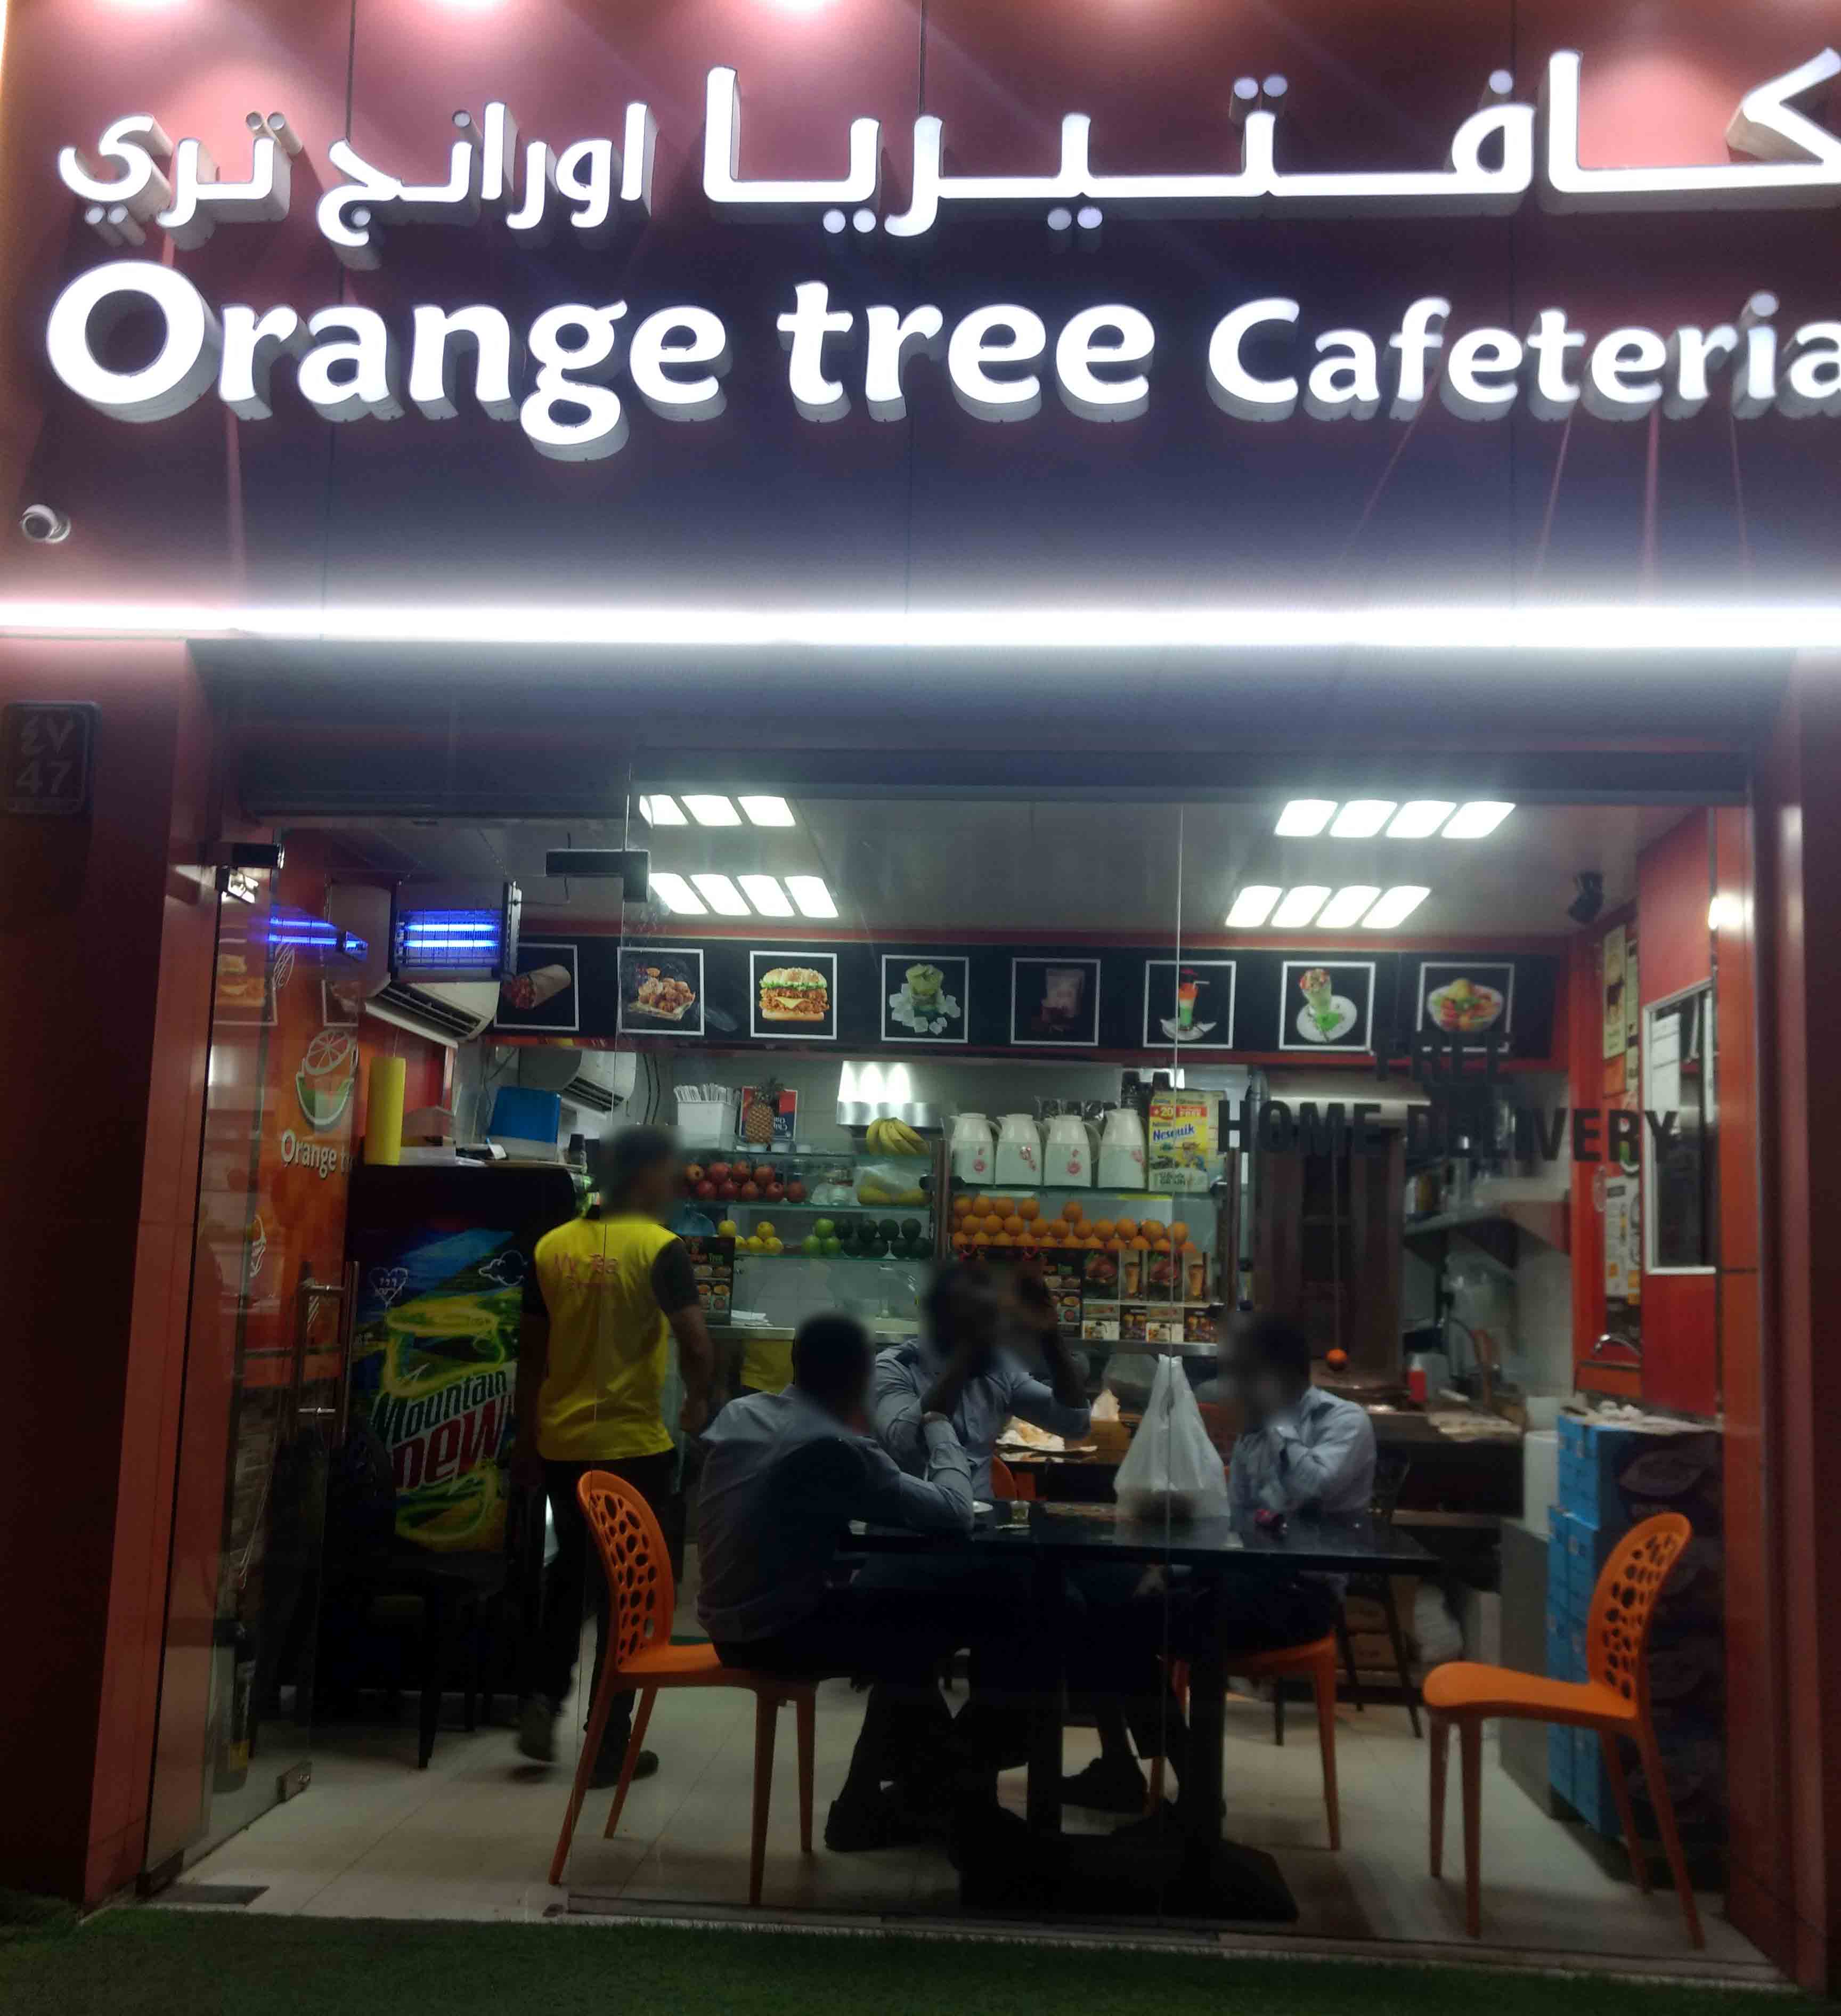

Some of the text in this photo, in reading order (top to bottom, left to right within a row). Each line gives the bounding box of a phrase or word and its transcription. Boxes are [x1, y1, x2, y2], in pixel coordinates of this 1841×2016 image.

[704, 49, 1841, 238] كافتيريا
[46, 260, 1841, 443] Orange tree Cafeteria
[281, 1129, 337, 1179] Orange
[1218, 1100, 1680, 1162] HOME DELIVERY
[372, 1371, 507, 1445] Mountain
